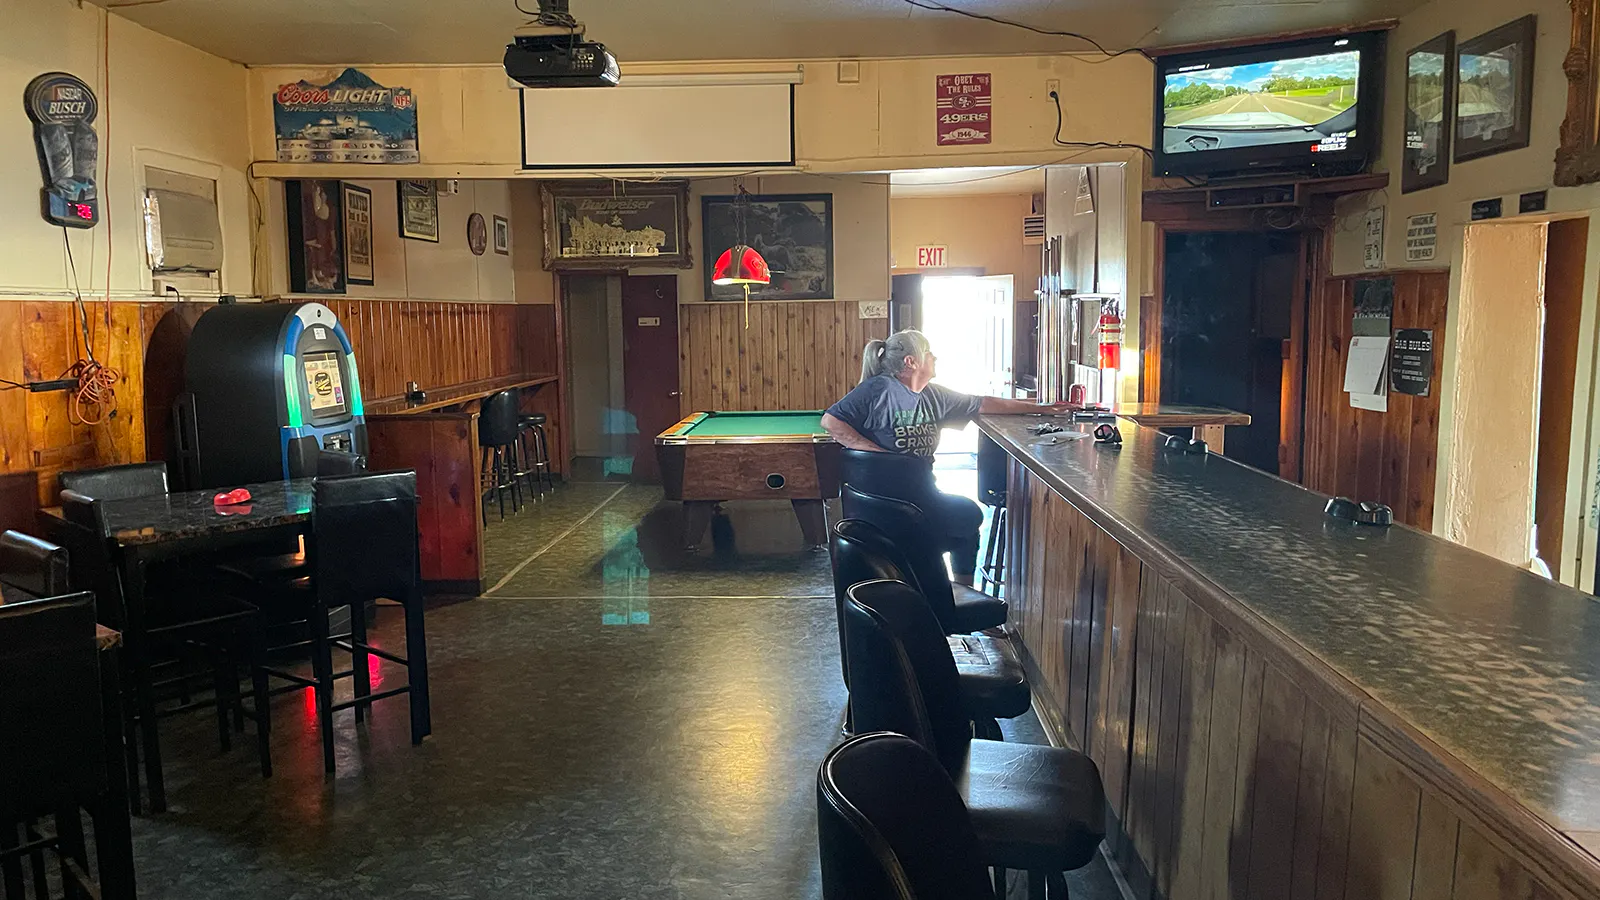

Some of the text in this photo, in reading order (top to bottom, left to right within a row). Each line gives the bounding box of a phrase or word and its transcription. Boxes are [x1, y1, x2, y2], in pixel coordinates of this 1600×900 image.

[277, 83, 387, 105] Coors LIGHT
[947, 85, 982, 95] THE RULES
[394, 97, 410, 107] NFL
[49, 101, 87, 115] BUSCH
[940, 113, 989, 124] 49ERS
[580, 199, 654, 209] Budweiser
[918, 248, 944, 266] EXIT
[1409, 340, 1430, 351] RULES
